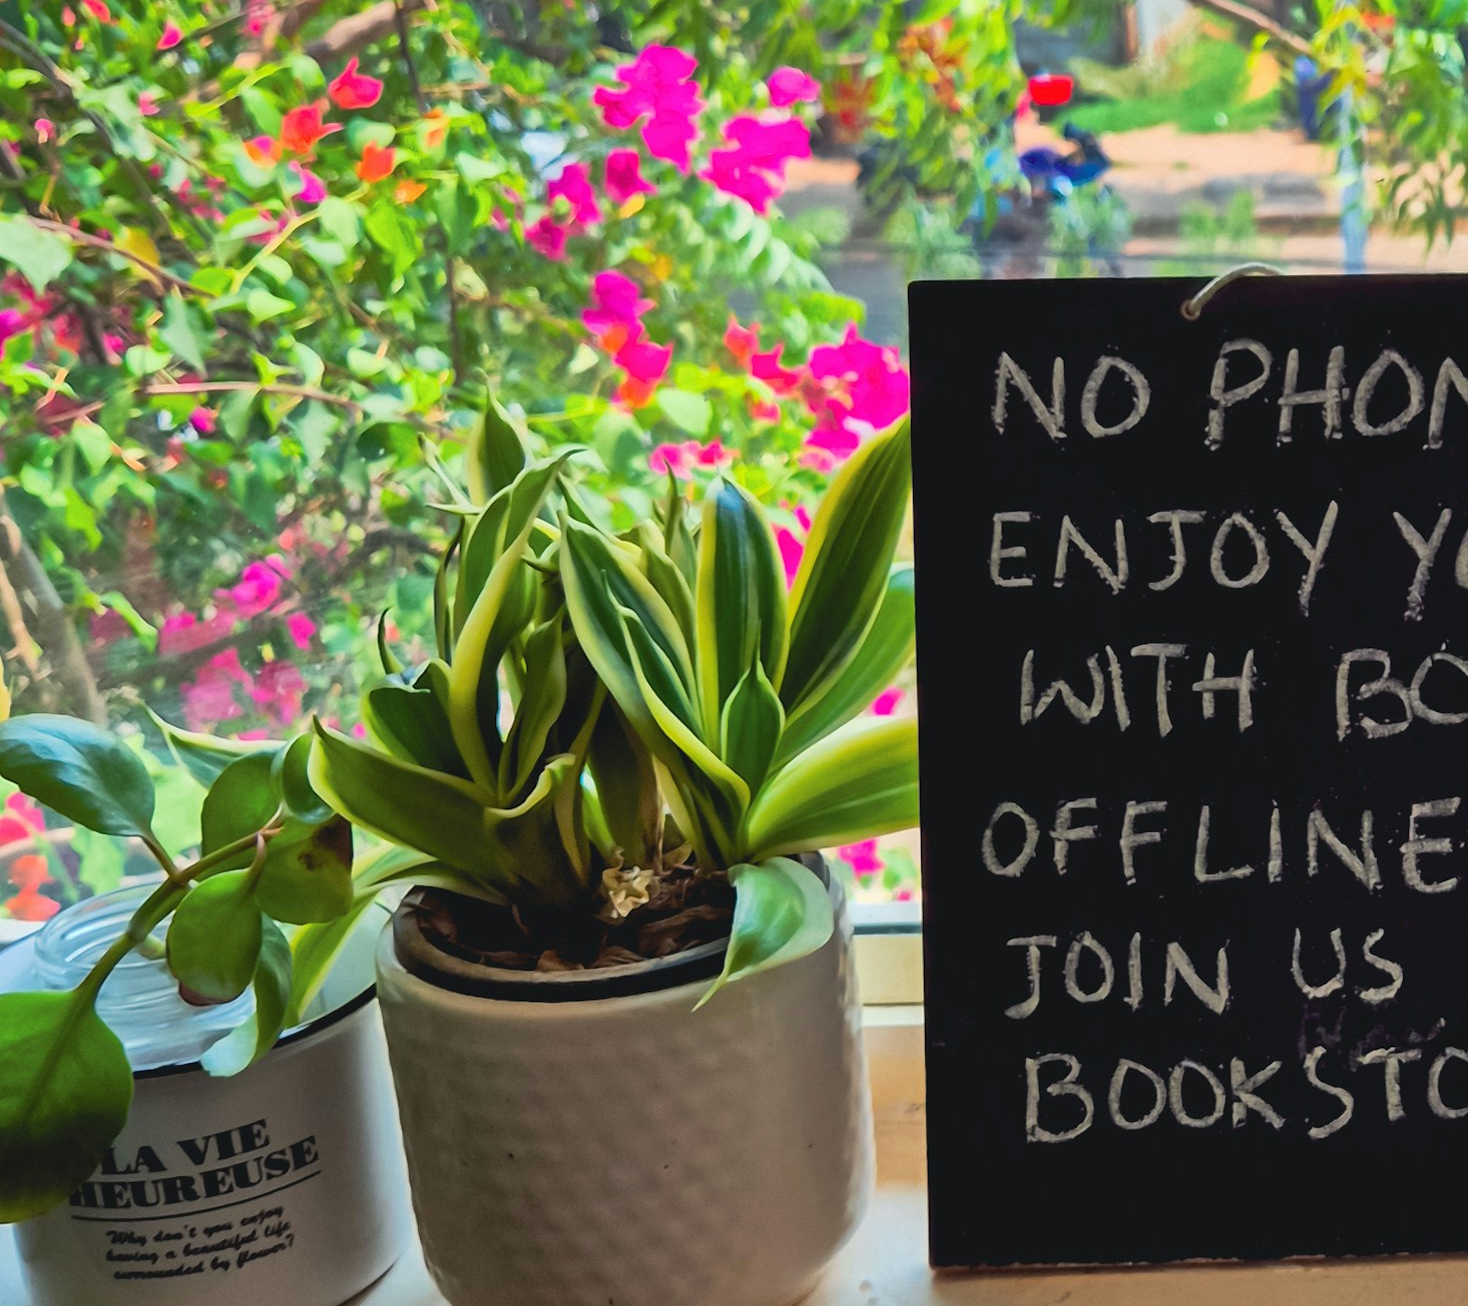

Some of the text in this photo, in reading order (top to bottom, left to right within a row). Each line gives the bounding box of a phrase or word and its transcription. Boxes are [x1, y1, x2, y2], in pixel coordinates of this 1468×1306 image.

[991, 352, 1150, 439] NO
[988, 500, 1338, 617] ENJOY
[1020, 643, 1257, 737] WITH
[982, 797, 1460, 893] OFFLINE
[1005, 931, 1231, 1018] JOIN
[1291, 928, 1403, 1005] US
[101, 1118, 270, 1175] LA VIE
[106, 1230, 147, 1247] Why
